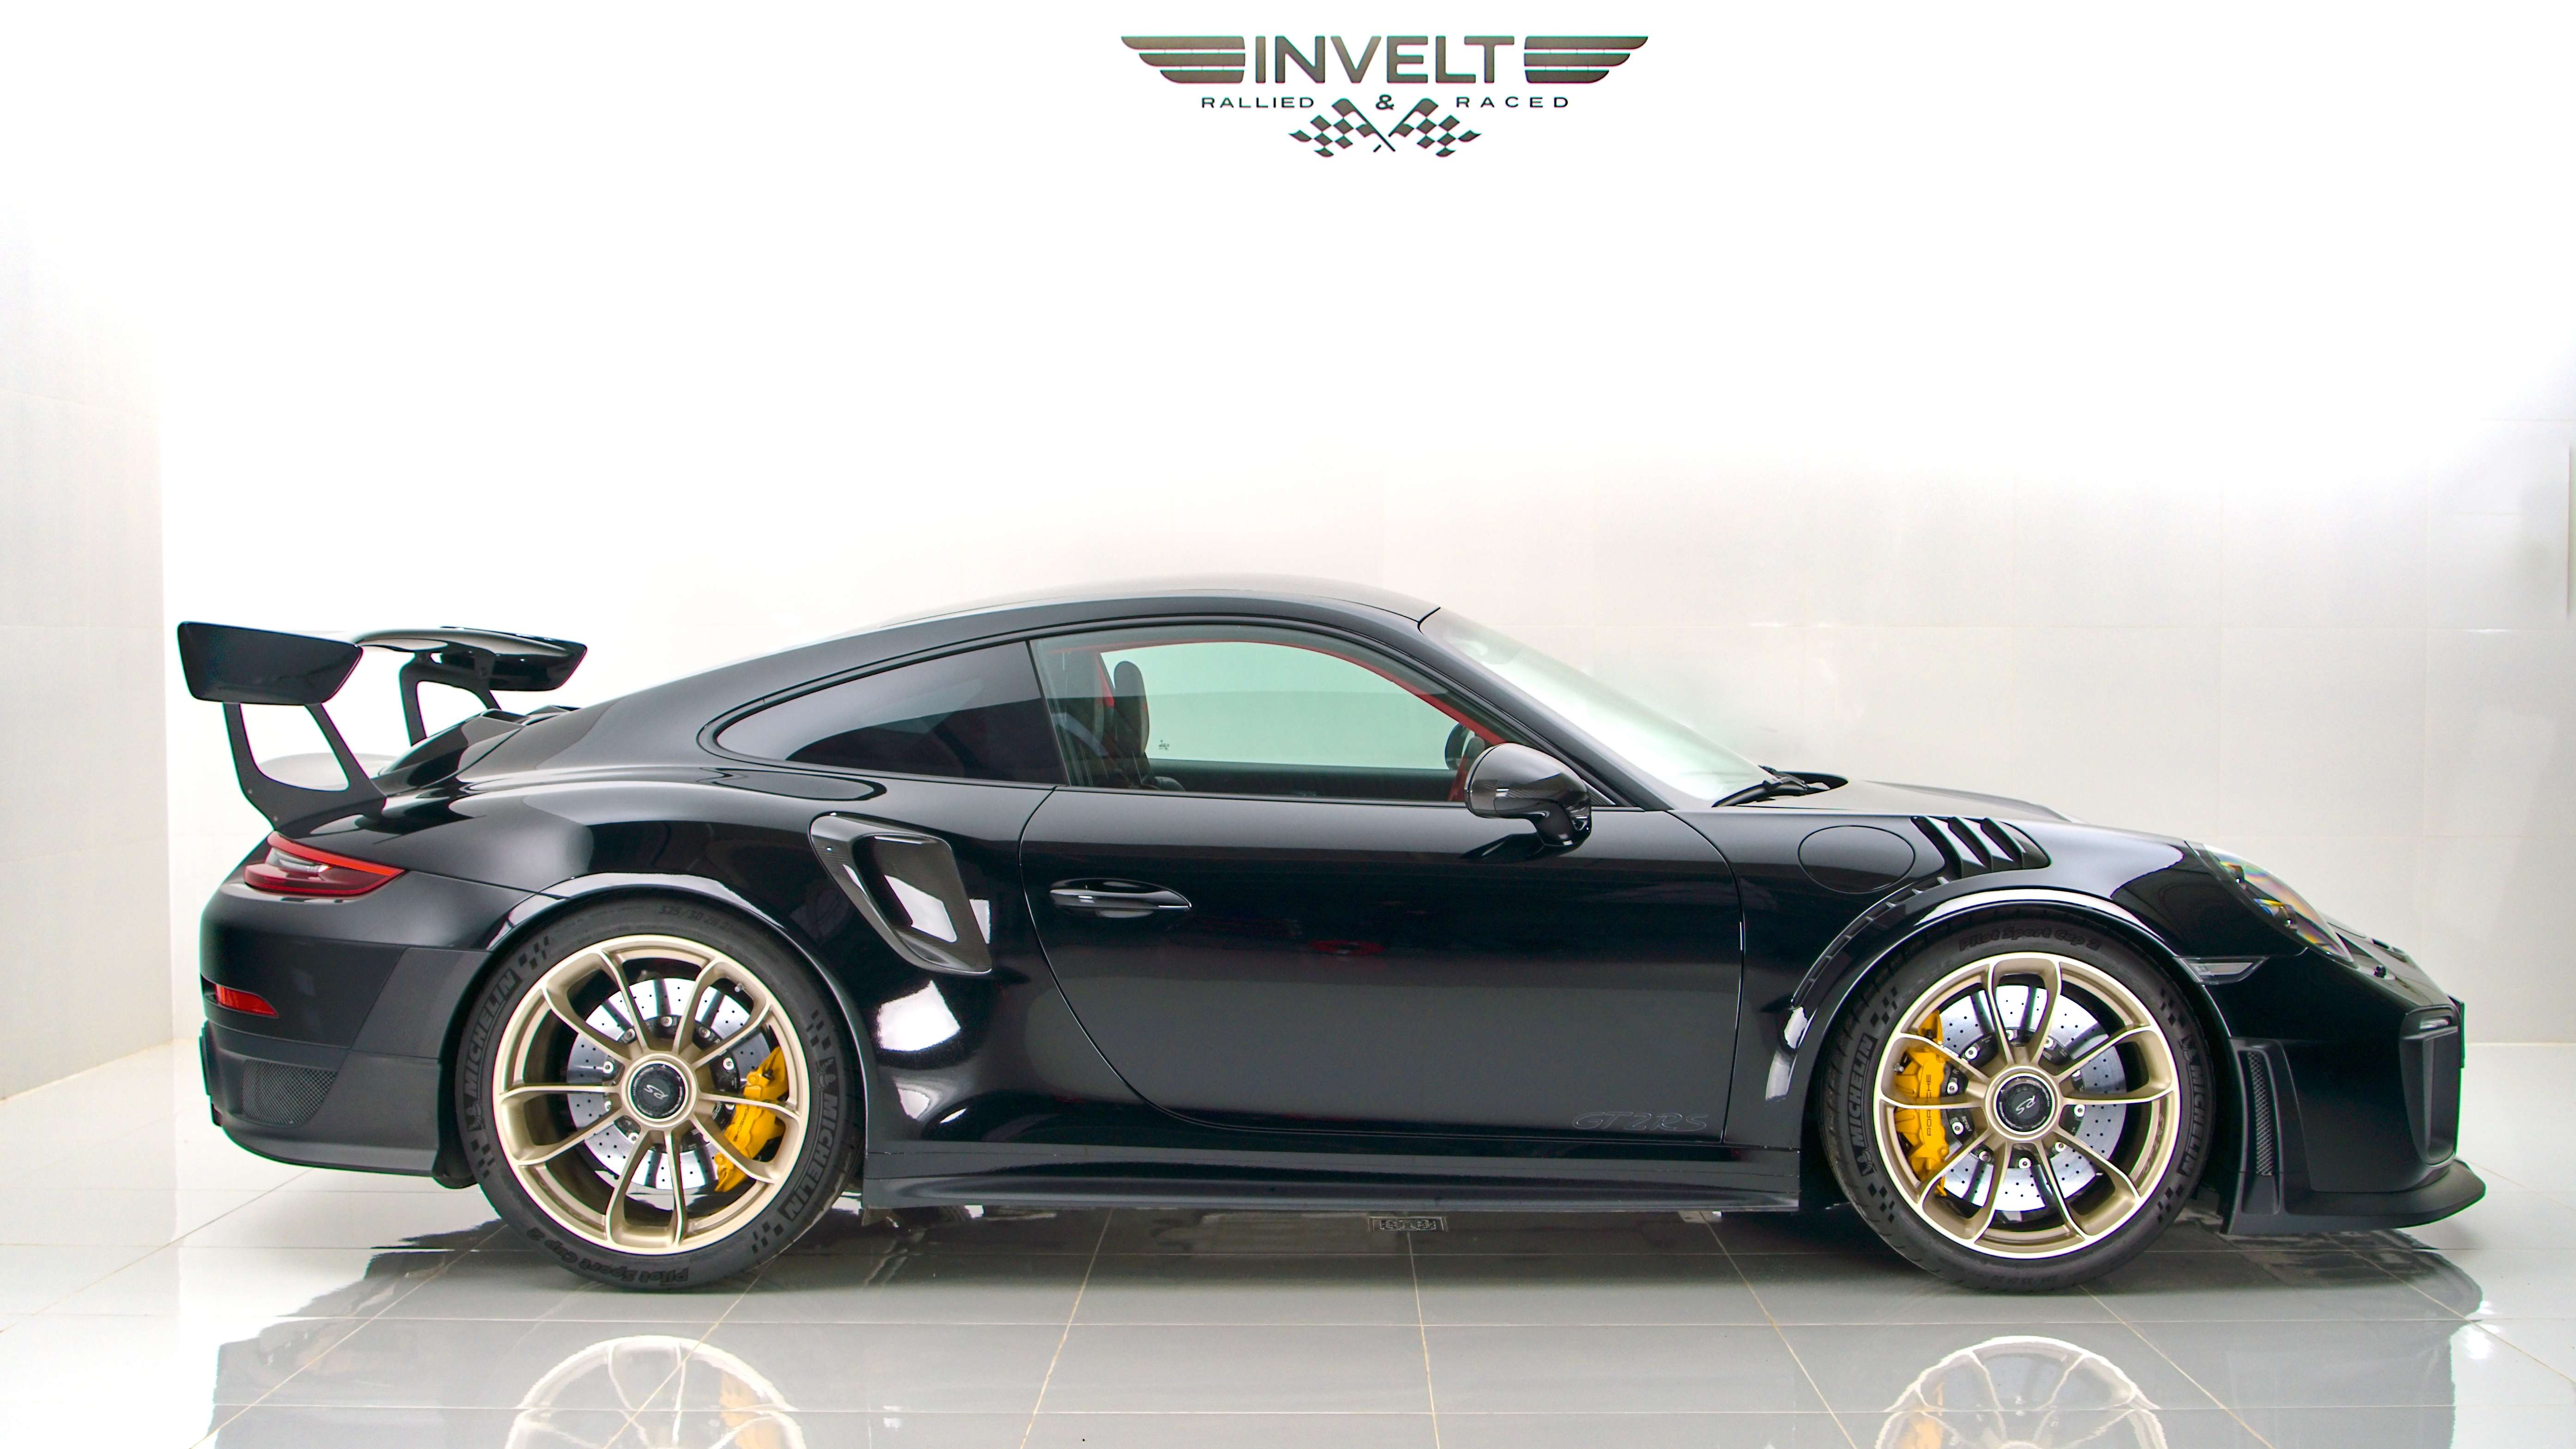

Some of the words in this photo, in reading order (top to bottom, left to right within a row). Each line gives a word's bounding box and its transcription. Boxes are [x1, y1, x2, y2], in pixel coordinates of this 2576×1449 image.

[1256, 36, 1514, 83] INVELT
[1202, 97, 1314, 108] RALLIED
[1375, 94, 1395, 110] &
[1456, 97, 1568, 108] RACED
[1958, 929, 2000, 951] Pilot
[2002, 926, 2052, 940] Sport
[2056, 929, 2085, 946] Cup
[2086, 938, 2100, 951] 2
[464, 969, 517, 1099] MICHELIN
[1848, 1033, 1874, 1147] MICHELIN
[2181, 1064, 2206, 1176] MICHELIN
[785, 1093, 838, 1221] MICHELIN
[526, 1227, 545, 1241] 2
[544, 1239, 577, 1263] Cup
[579, 1258, 639, 1282] Sport
[639, 1268, 689, 1283] Pilot
